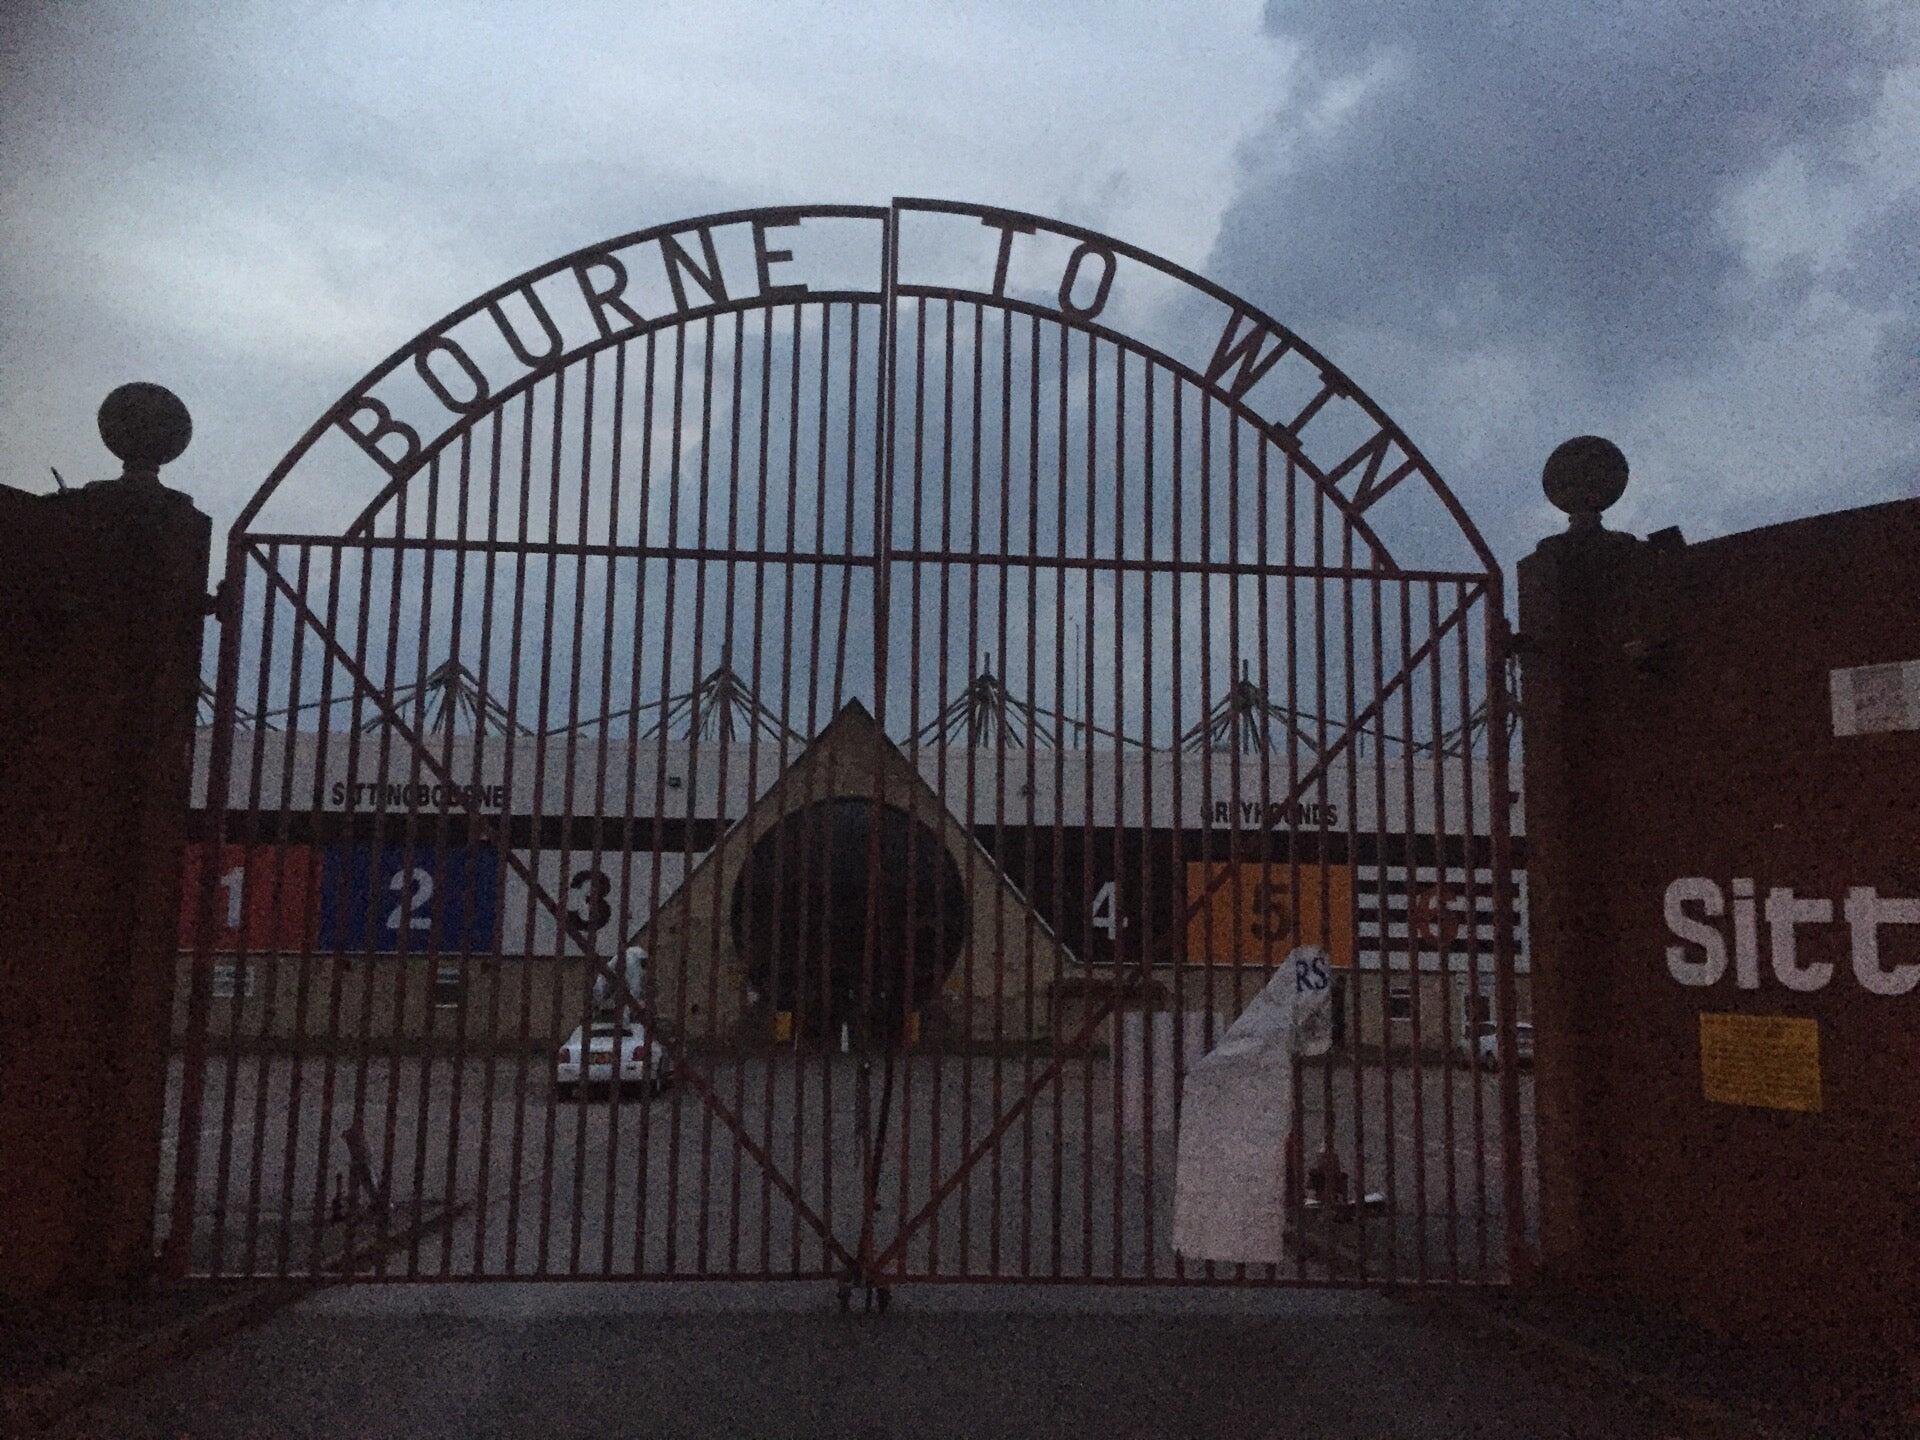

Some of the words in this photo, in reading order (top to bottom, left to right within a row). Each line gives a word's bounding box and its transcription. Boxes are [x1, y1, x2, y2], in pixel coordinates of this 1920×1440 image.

[333, 210, 808, 482] BOURNE
[981, 212, 1118, 322] TO
[1202, 304, 1422, 514] WIN
[220, 866, 246, 929] 1
[386, 868, 434, 930] 2
[567, 870, 612, 931] 3
[1092, 880, 1128, 941] 4
[1251, 880, 1293, 942] 5
[1663, 876, 1920, 996] Sitt
